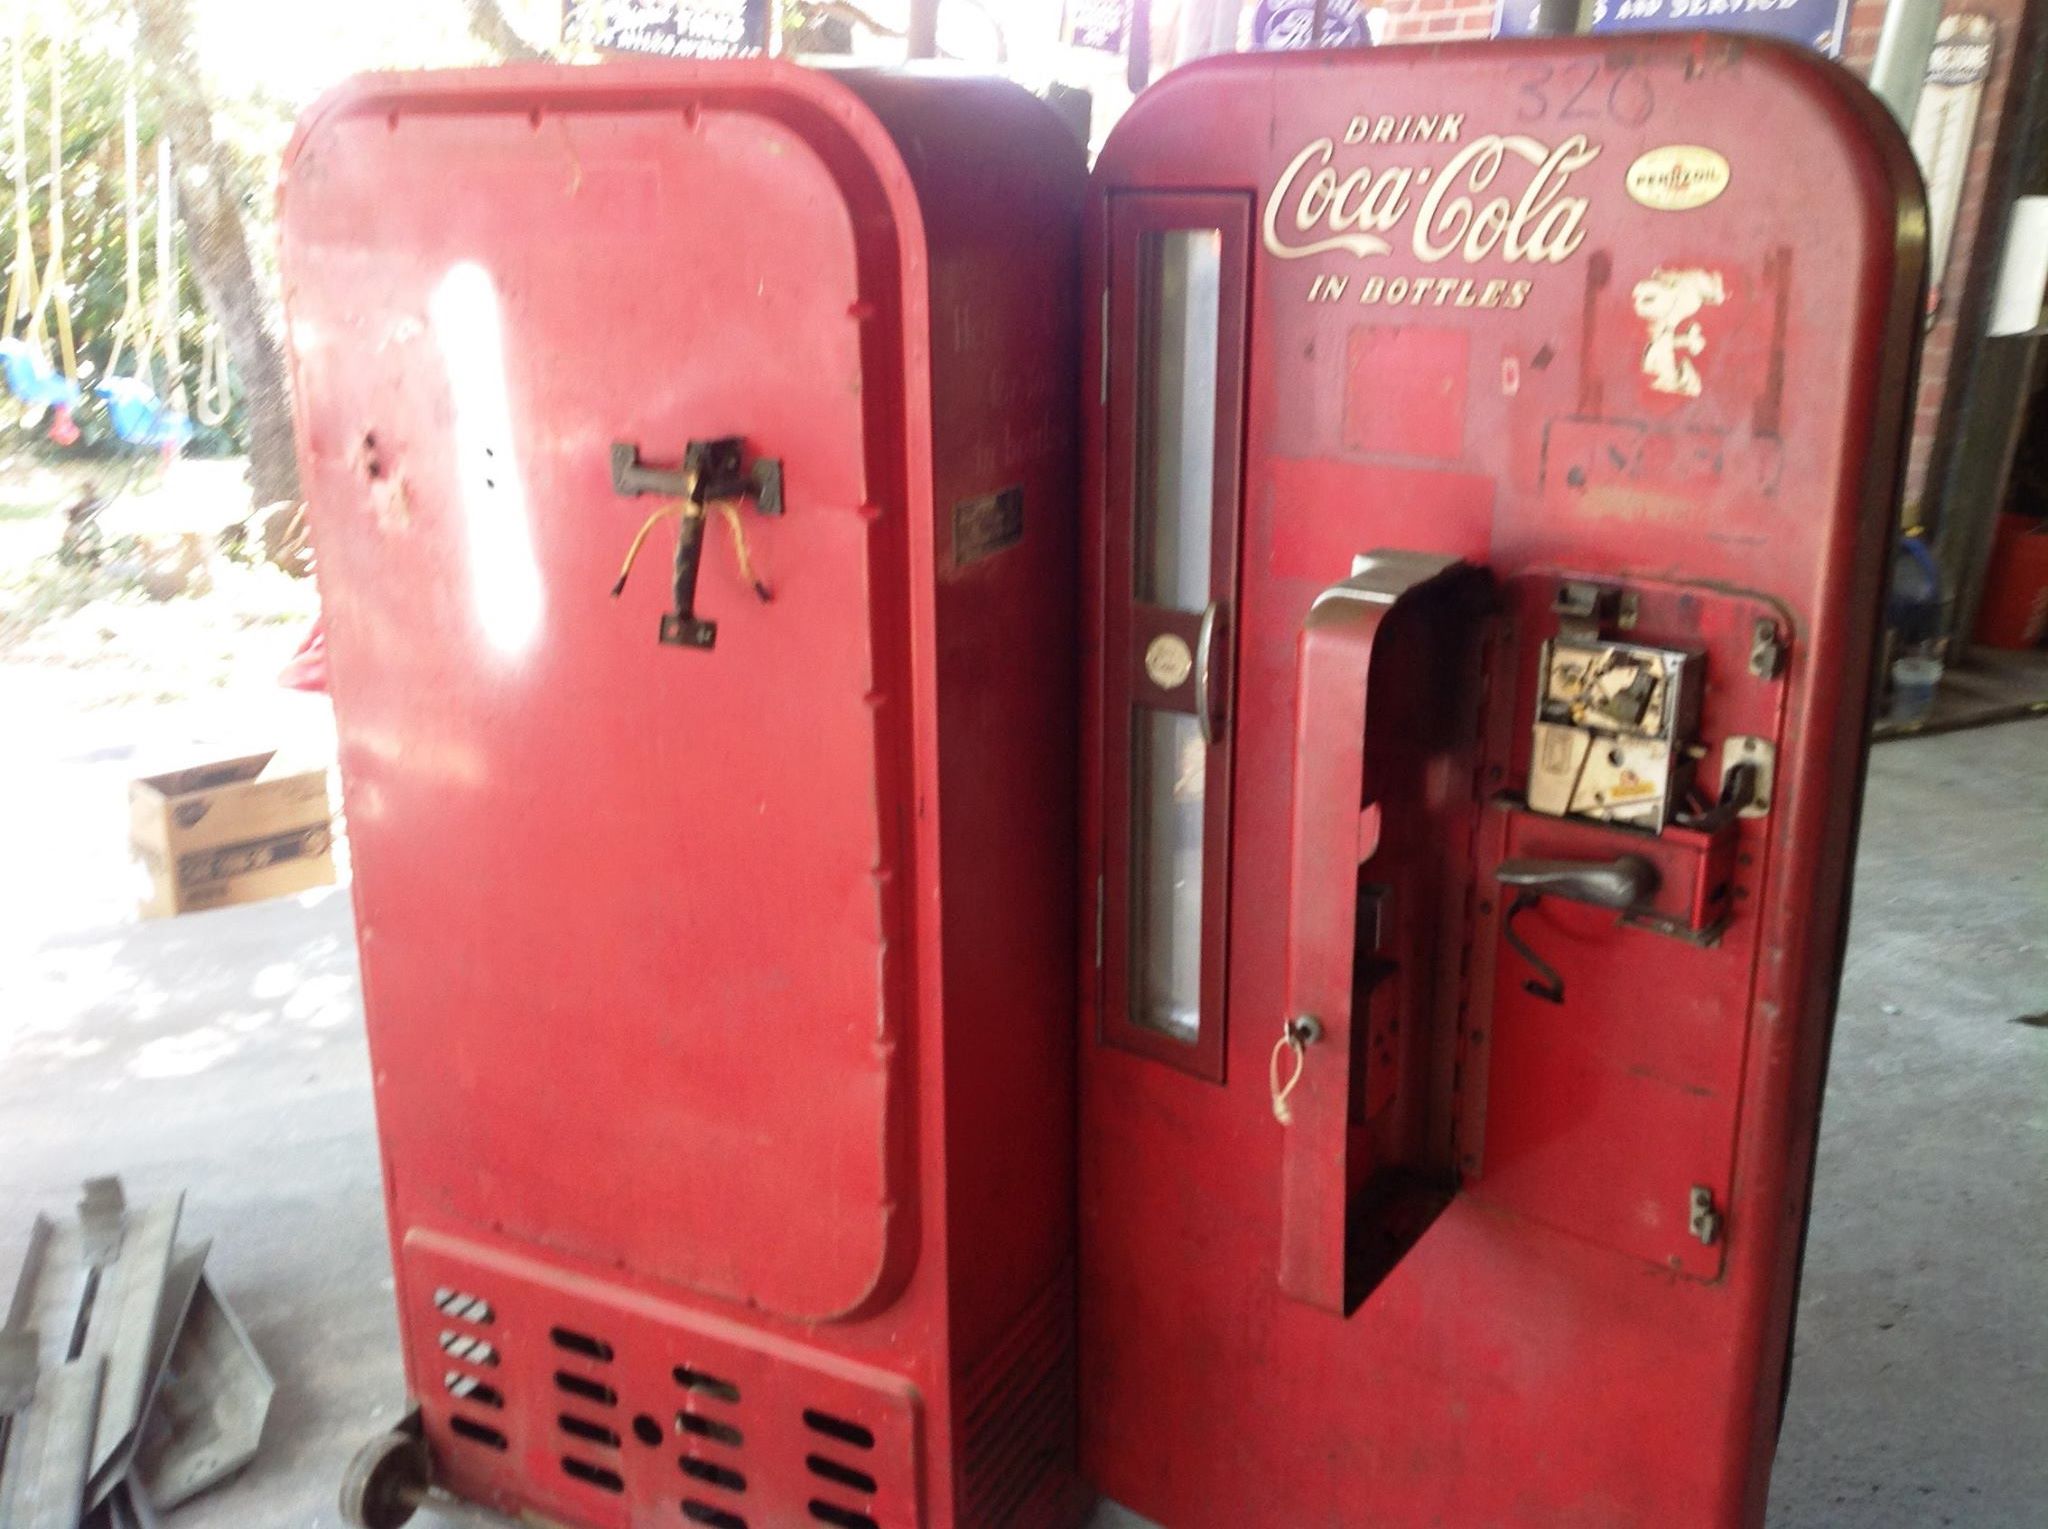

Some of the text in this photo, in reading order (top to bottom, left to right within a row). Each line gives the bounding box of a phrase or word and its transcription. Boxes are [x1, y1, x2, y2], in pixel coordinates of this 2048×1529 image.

[1343, 113, 1465, 144] DRINK
[1307, 274, 1349, 302] IN
[1360, 275, 1533, 309] BOTTLES
